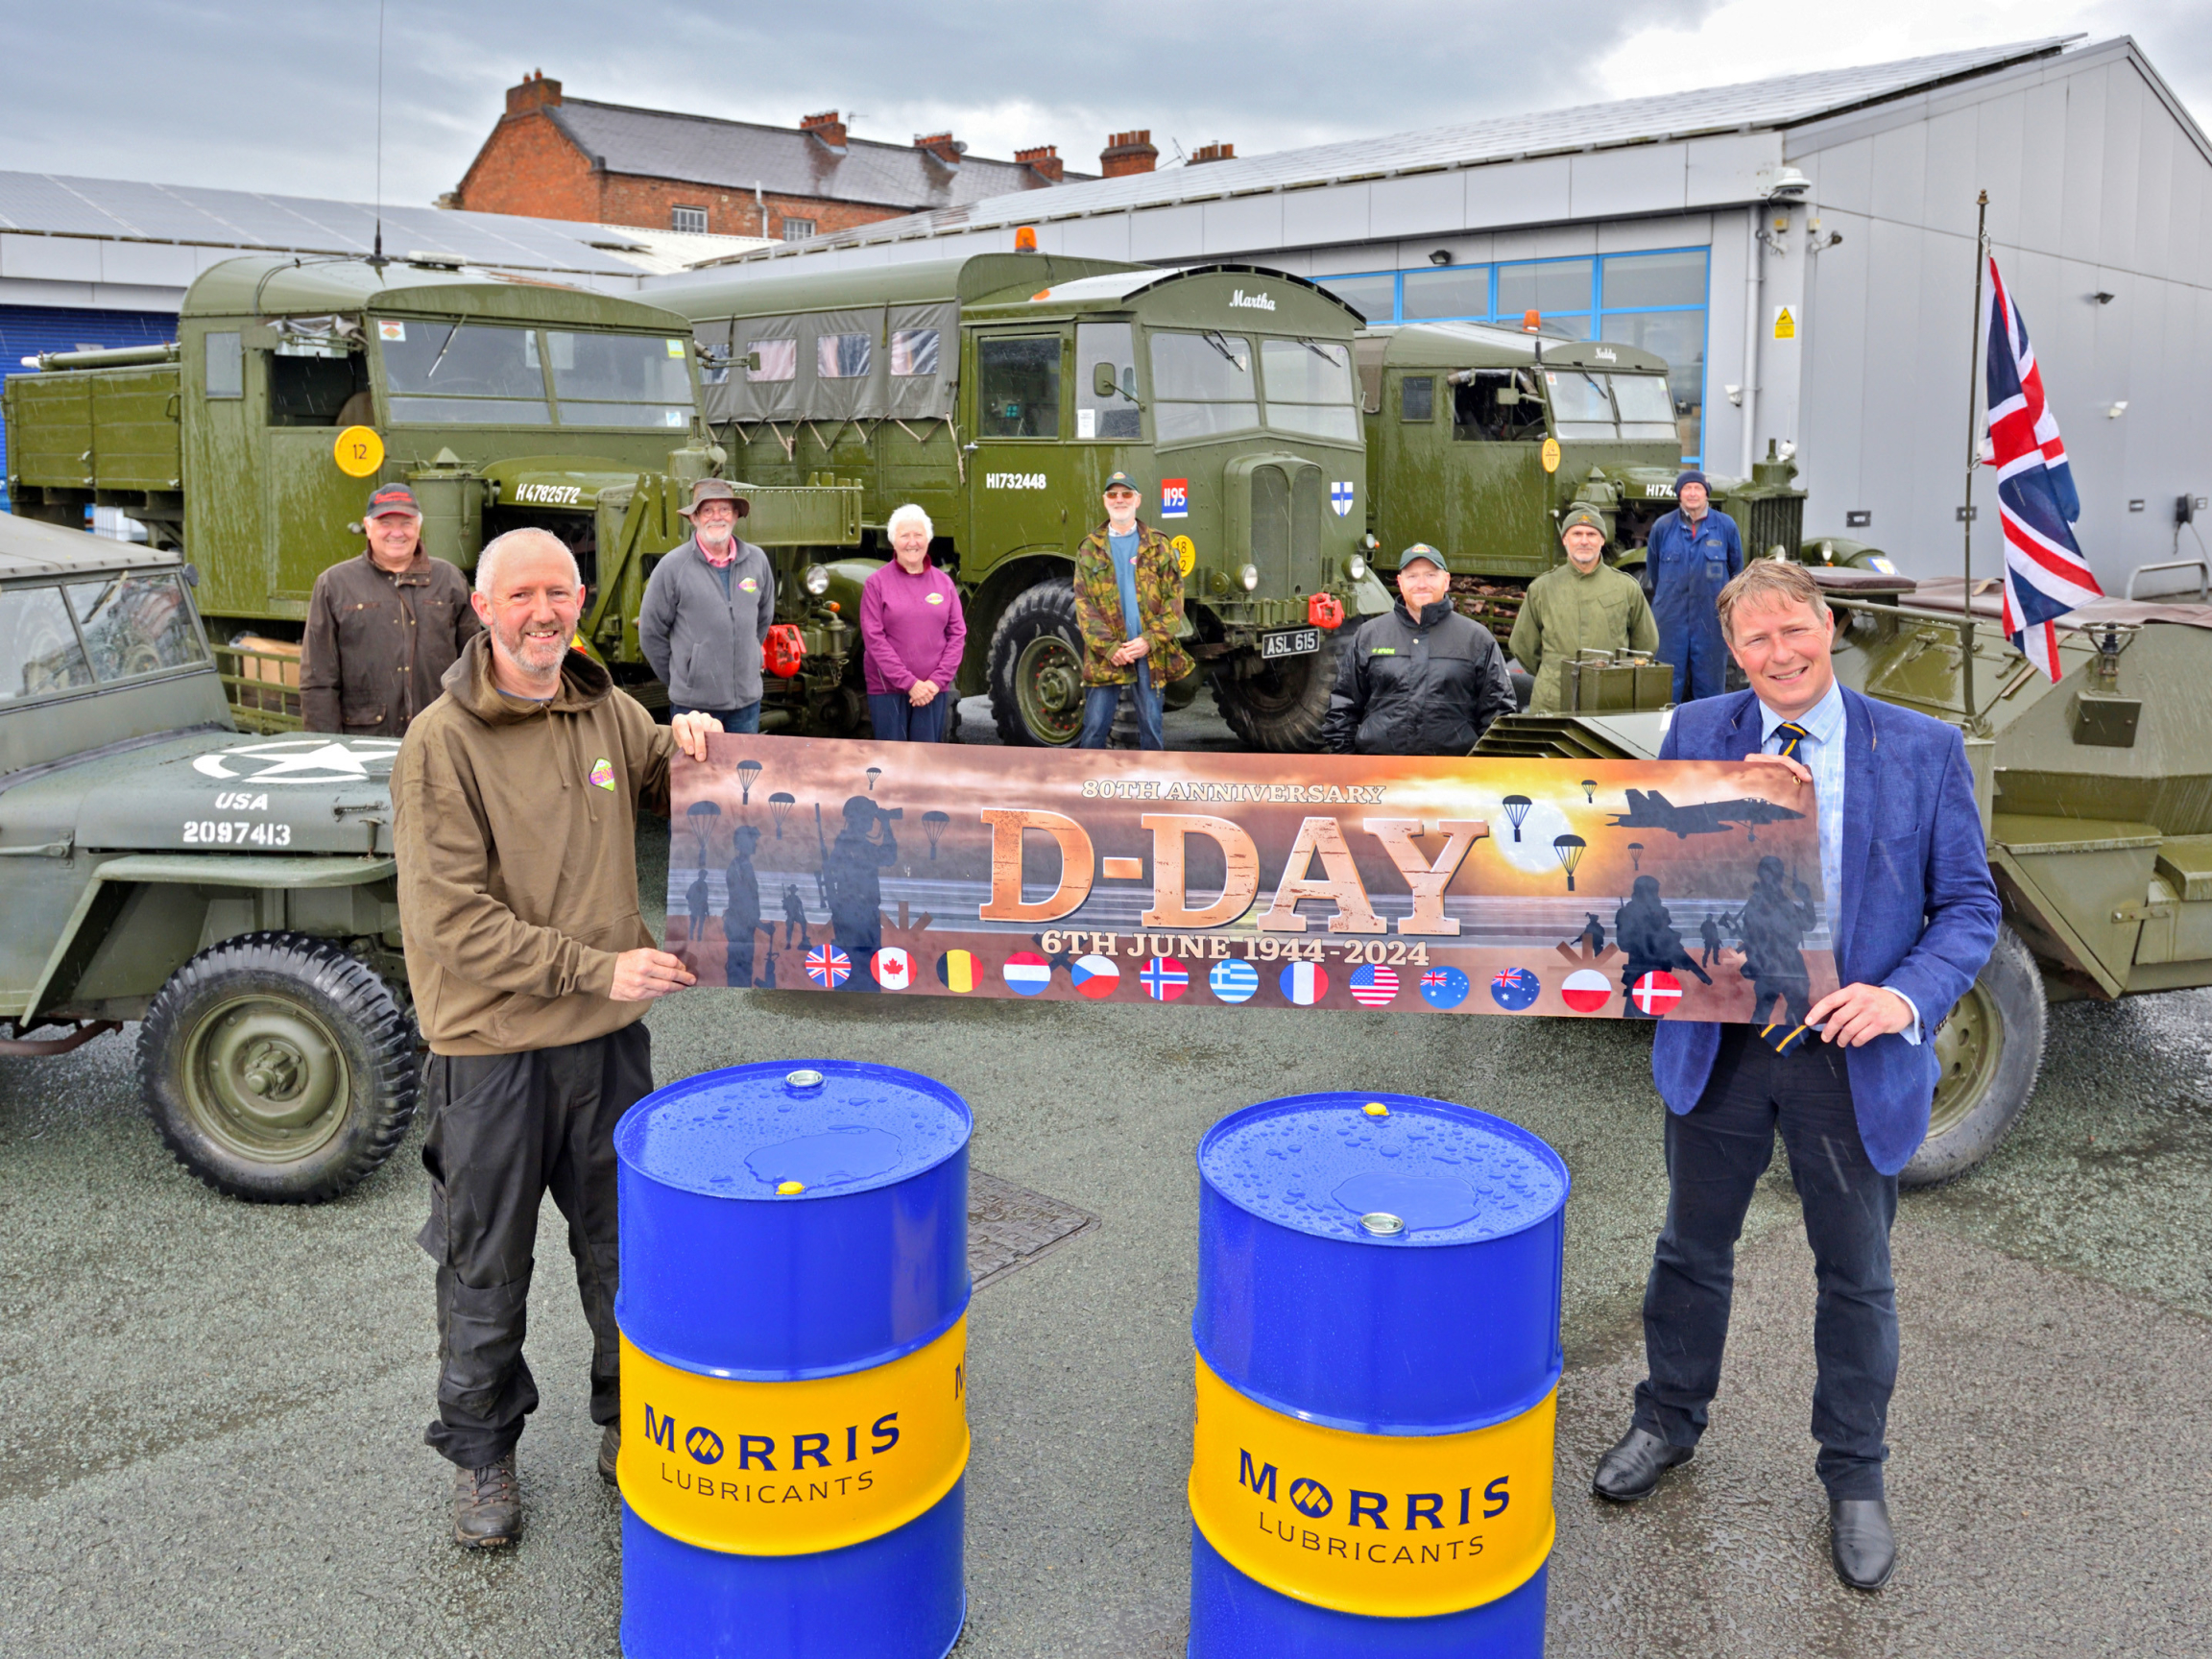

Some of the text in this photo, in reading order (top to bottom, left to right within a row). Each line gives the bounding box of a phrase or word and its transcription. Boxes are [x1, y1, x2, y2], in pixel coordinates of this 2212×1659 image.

[1229, 289, 1276, 311] Martha
[352, 444, 368, 460] 12
[516, 483, 582, 504] H4782572
[1267, 633, 1315, 655] ASL 615
[215, 792, 269, 810] USA
[1081, 780, 1386, 805] 80TH ANNIVERSARY
[182, 821, 291, 846] 2097413
[979, 807, 1490, 936] D-DAY
[1041, 929, 1118, 958] 6TH
[1126, 932, 1232, 960] JUNE
[644, 1402, 901, 1472] MORRIS
[661, 1461, 874, 1503] LUBRICANTS
[1238, 1447, 1510, 1530] MORRIS
[1259, 1511, 1484, 1565] LUBRICANTS
